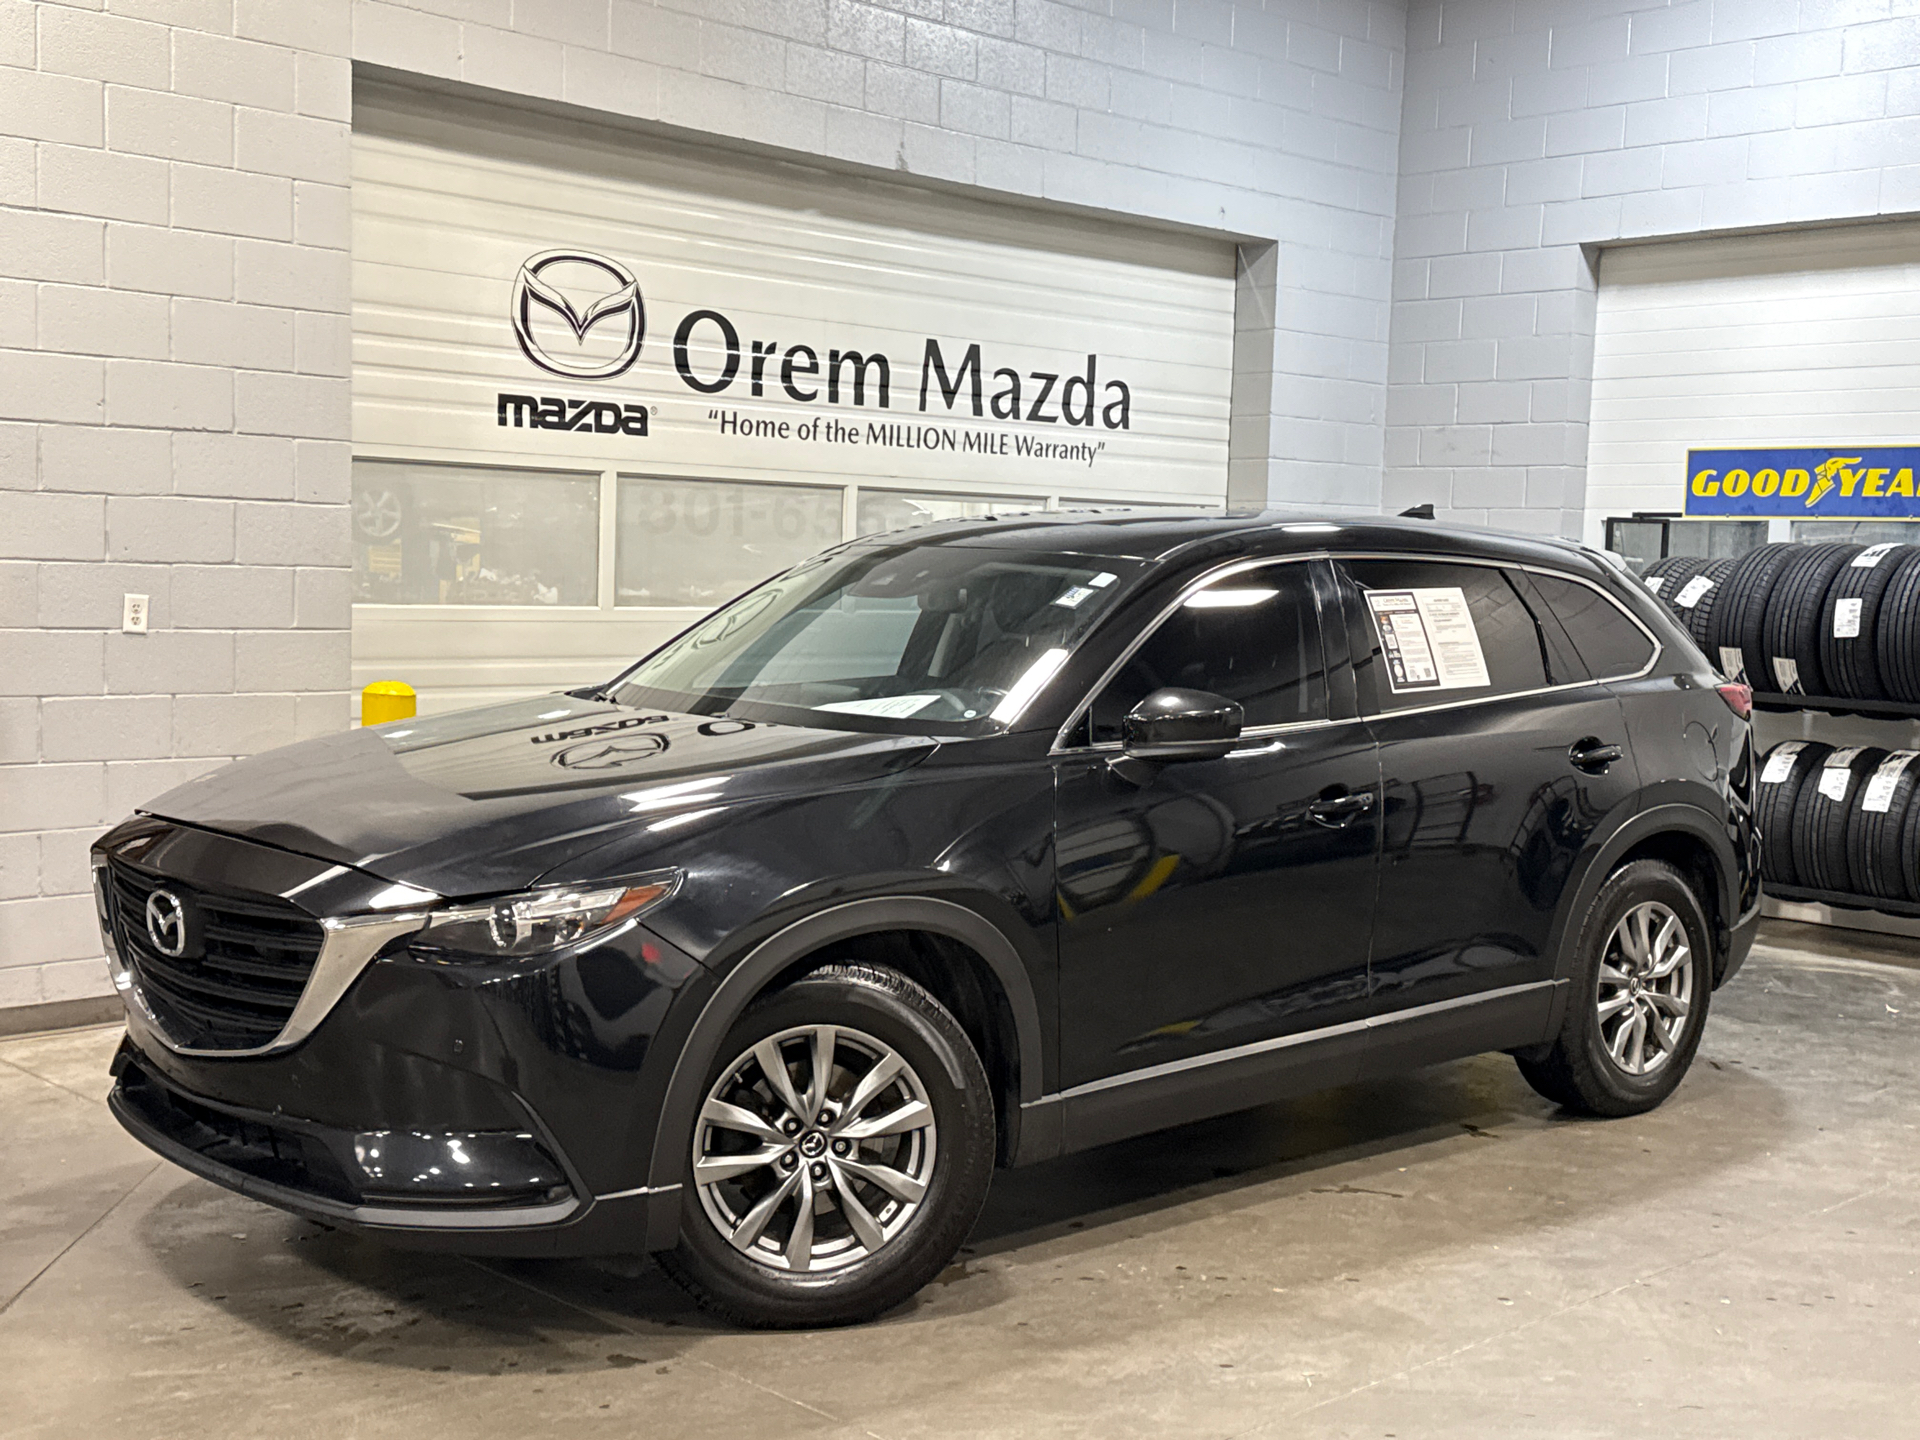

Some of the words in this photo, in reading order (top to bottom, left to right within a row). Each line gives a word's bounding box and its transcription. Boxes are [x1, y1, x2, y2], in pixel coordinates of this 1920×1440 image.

[673, 309, 890, 409] Orem
[918, 338, 1131, 430] Mazda
[708, 409, 790, 441] “Home
[797, 417, 821, 443] of
[825, 418, 859, 445] the
[866, 422, 956, 451] MILLION
[963, 430, 1009, 456] MILE
[1014, 435, 1105, 468] Warranty”
[1691, 467, 1920, 498] GOODYEA
